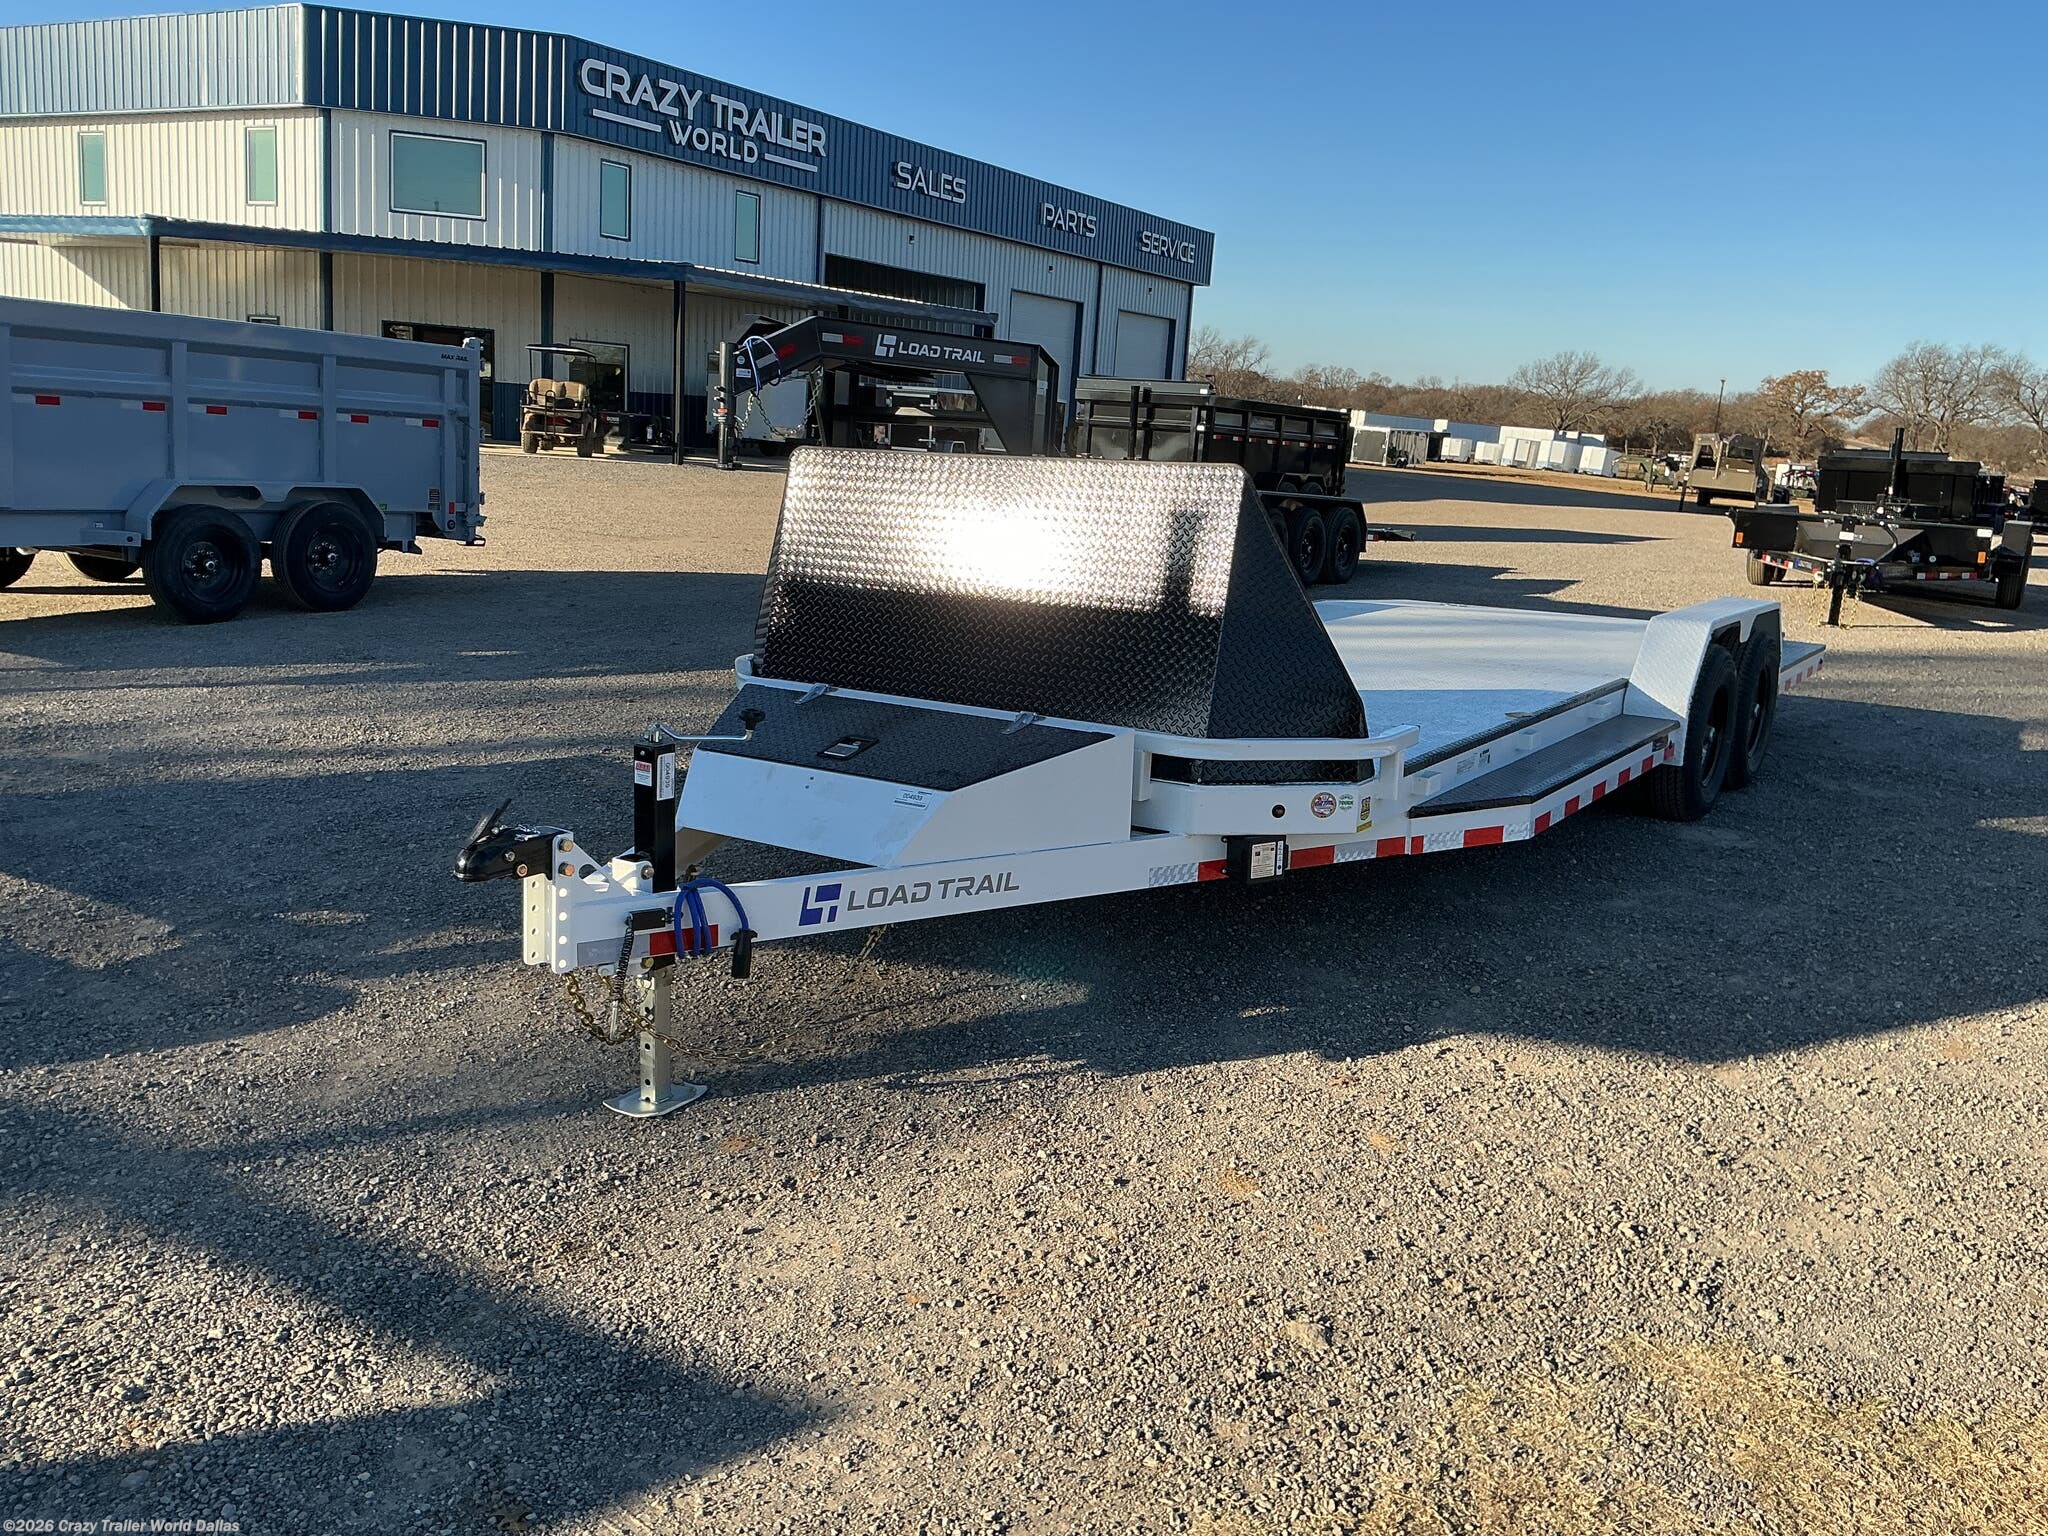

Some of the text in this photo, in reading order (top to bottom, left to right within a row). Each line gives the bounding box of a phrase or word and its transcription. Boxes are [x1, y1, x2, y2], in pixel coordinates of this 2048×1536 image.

[581, 58, 827, 157] CRAZY TRAILER
[668, 119, 760, 164] WORLD
[896, 161, 968, 205] SALES
[1042, 202, 1098, 239] PARTS
[1140, 230, 1196, 264] SERVICE
[898, 341, 986, 364] LOAD TRAIL
[847, 871, 1020, 912] LOAD TRAIL
